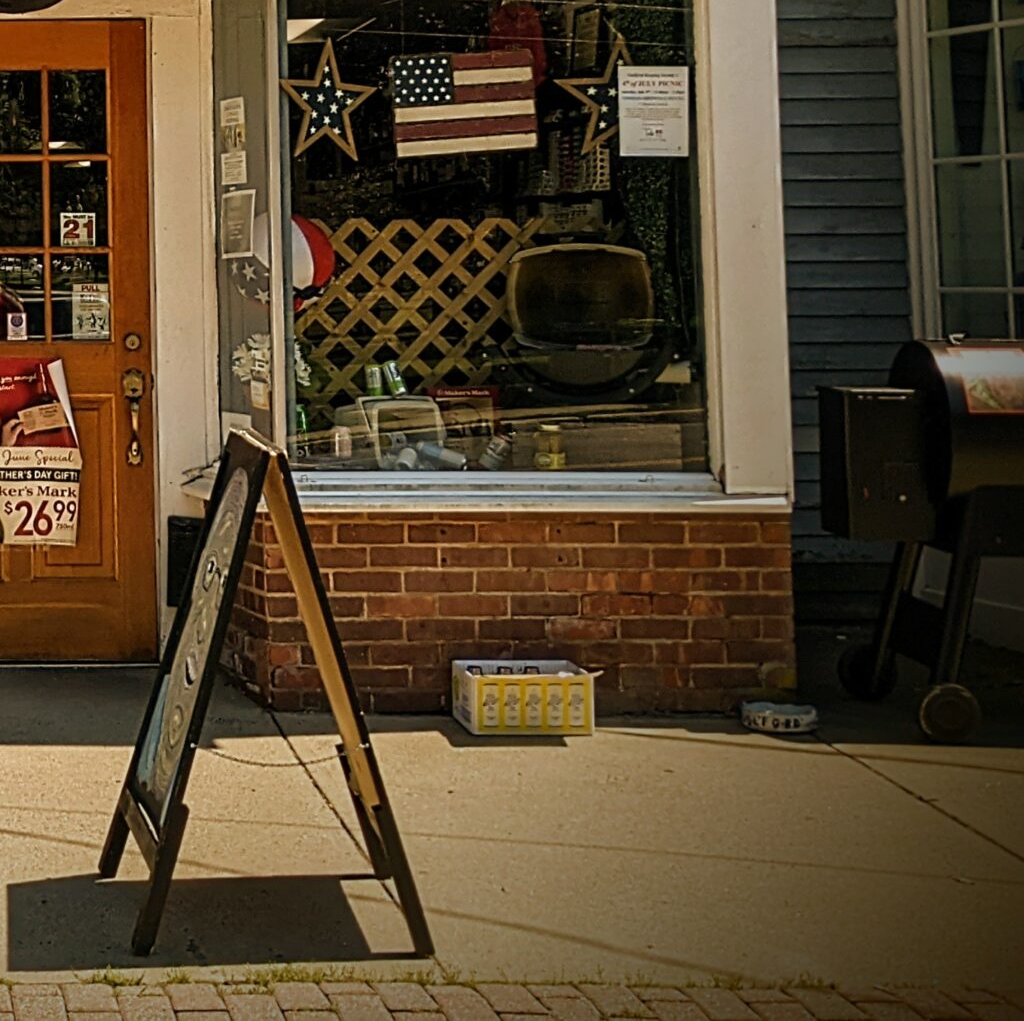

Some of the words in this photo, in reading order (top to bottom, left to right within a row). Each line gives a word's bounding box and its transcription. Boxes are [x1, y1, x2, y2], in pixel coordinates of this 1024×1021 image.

[63, 219, 94, 239] 21
[81, 284, 100, 292] PULL
[2, 449, 31, 466] June
[34, 471, 52, 479] DAY
[53, 471, 78, 480] GIFT!
[37, 486, 77, 497] Mark
